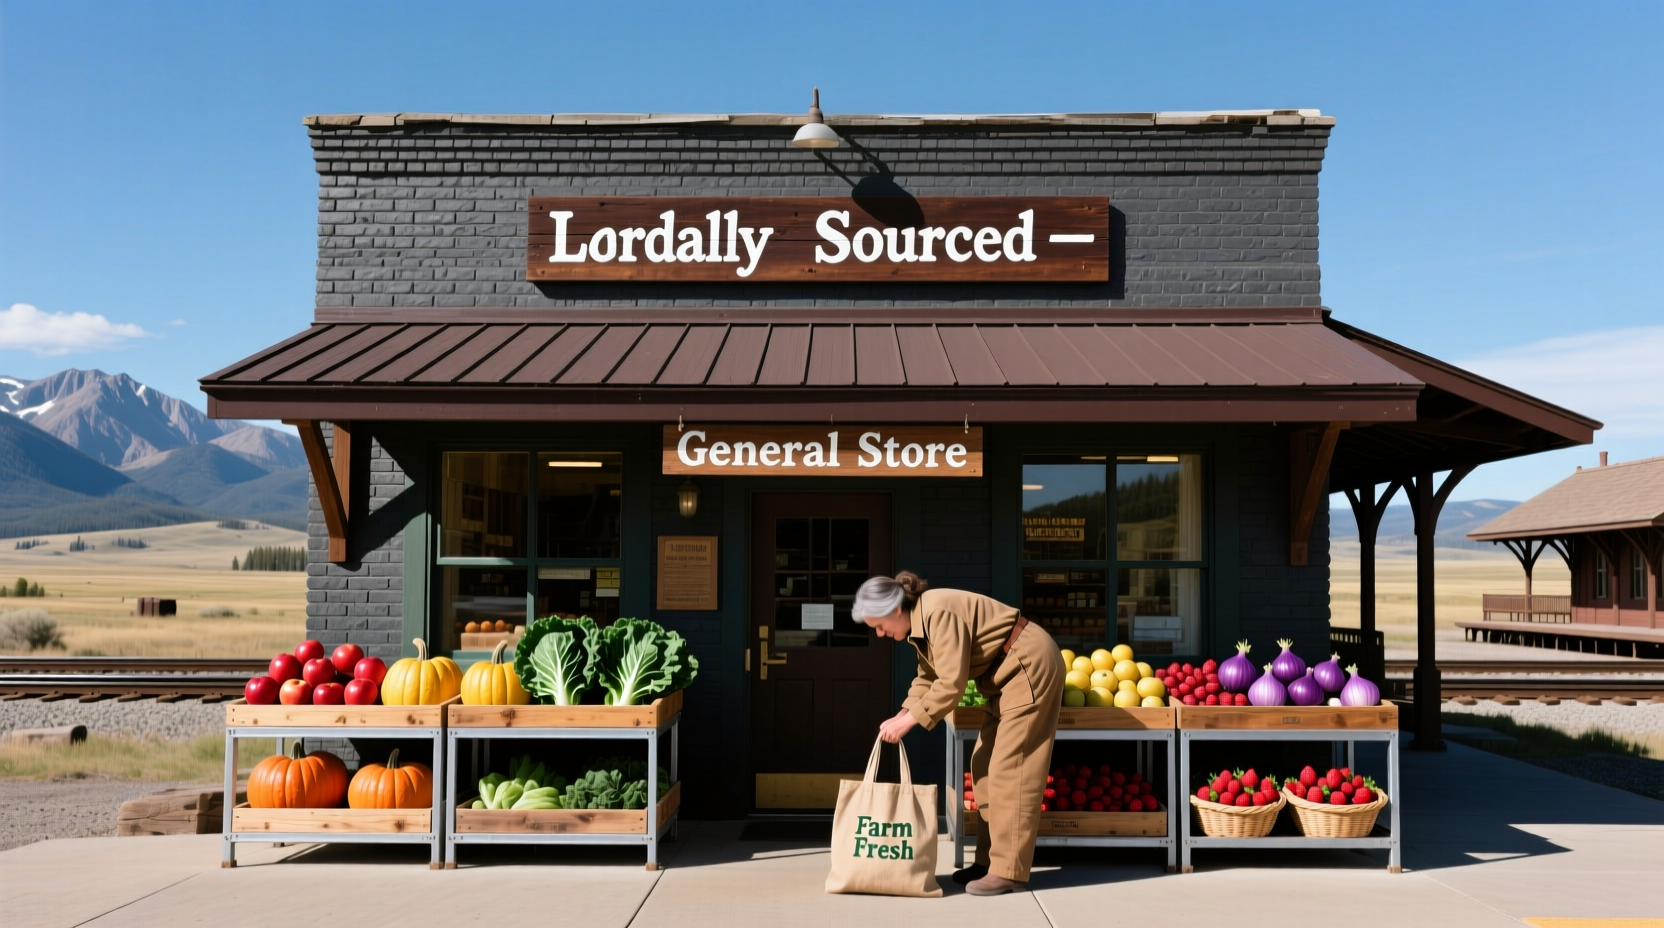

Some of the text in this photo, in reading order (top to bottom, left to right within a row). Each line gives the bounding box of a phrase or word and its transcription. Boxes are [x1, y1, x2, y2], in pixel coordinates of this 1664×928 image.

[549, 210, 774, 277] Lordally
[815, 209, 1037, 264] Sourced
[677, 430, 967, 468] General Store
[855, 815, 913, 838] Farm
[853, 837, 914, 860] Fresh
